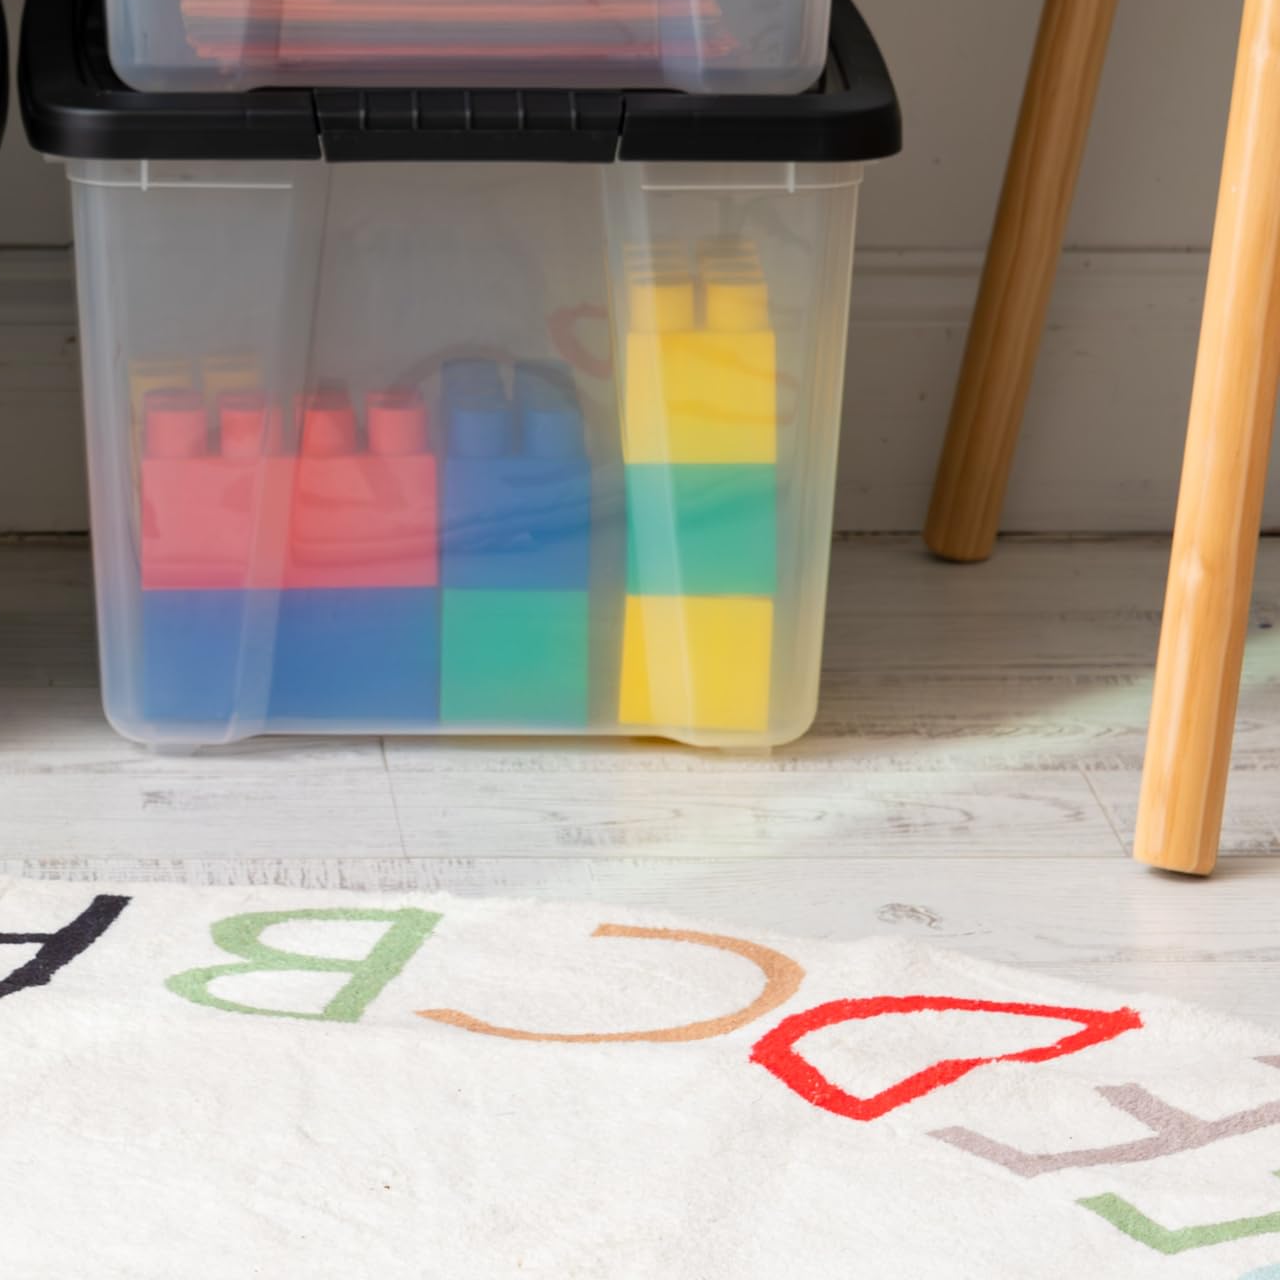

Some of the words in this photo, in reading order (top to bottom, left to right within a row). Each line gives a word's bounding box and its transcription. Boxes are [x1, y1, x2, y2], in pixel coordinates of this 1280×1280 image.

[166, 906, 445, 1023] B
[416, 923, 805, 1043] C
[749, 995, 1143, 1121] D
